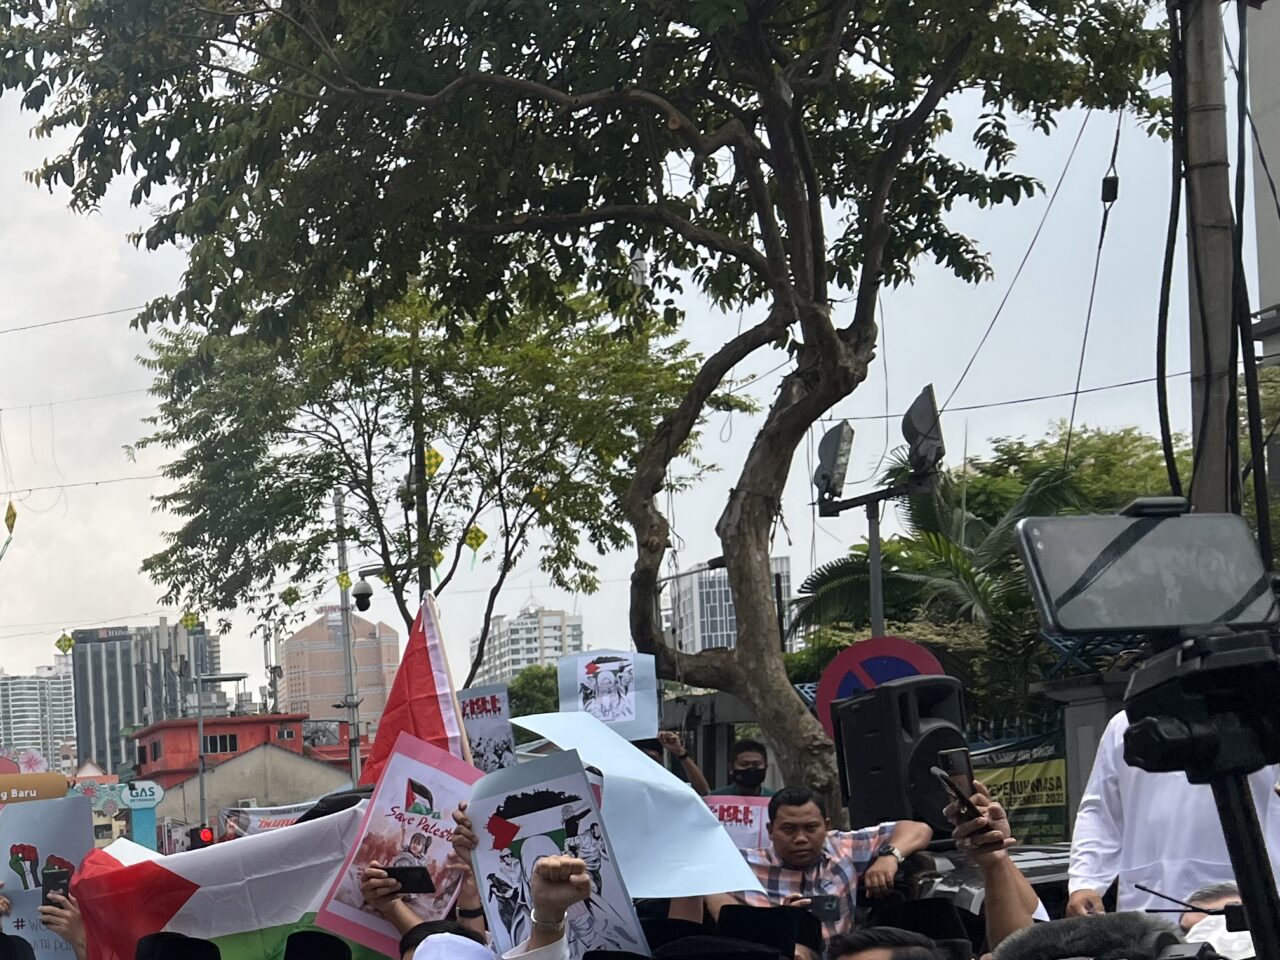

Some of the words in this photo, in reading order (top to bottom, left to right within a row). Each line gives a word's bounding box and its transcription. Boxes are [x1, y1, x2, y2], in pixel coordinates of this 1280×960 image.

[1031, 776, 1063, 793] MASA
[11, 788, 37, 798] Baru
[130, 786, 155, 798] GAS
[384, 806, 415, 825] Save
[416, 816, 453, 842] Palesti
